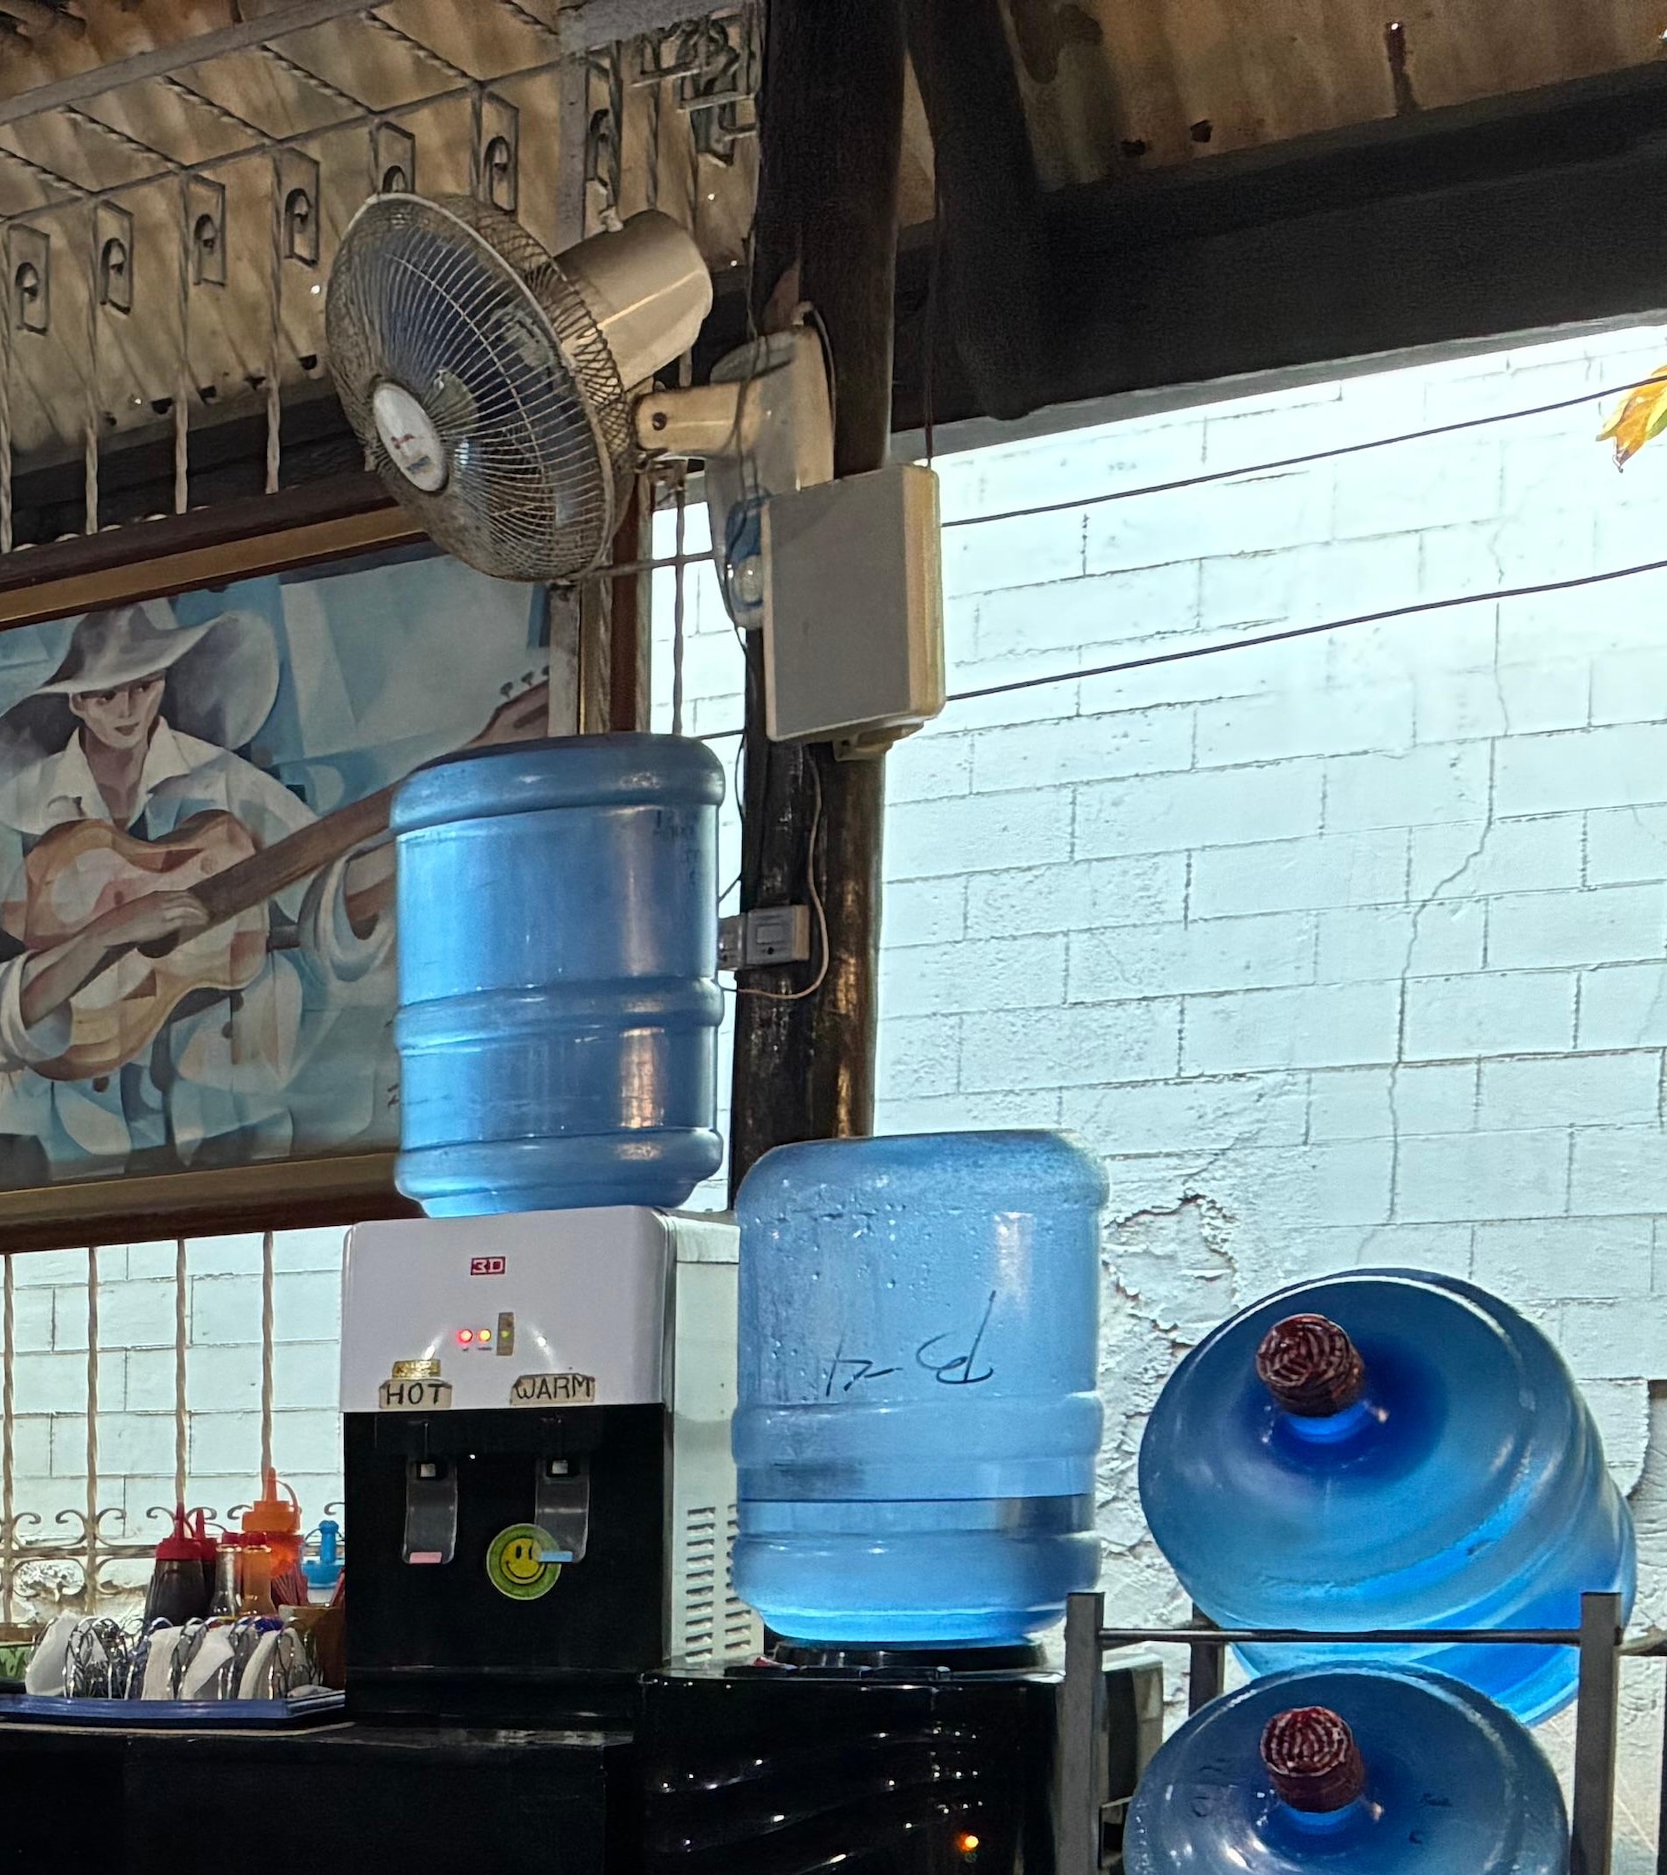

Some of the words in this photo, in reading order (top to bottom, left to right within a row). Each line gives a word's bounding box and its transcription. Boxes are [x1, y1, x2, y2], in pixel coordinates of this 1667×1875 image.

[471, 1258, 504, 1273] 3D
[386, 1382, 447, 1405] HOT
[517, 1374, 591, 1399] WARM
